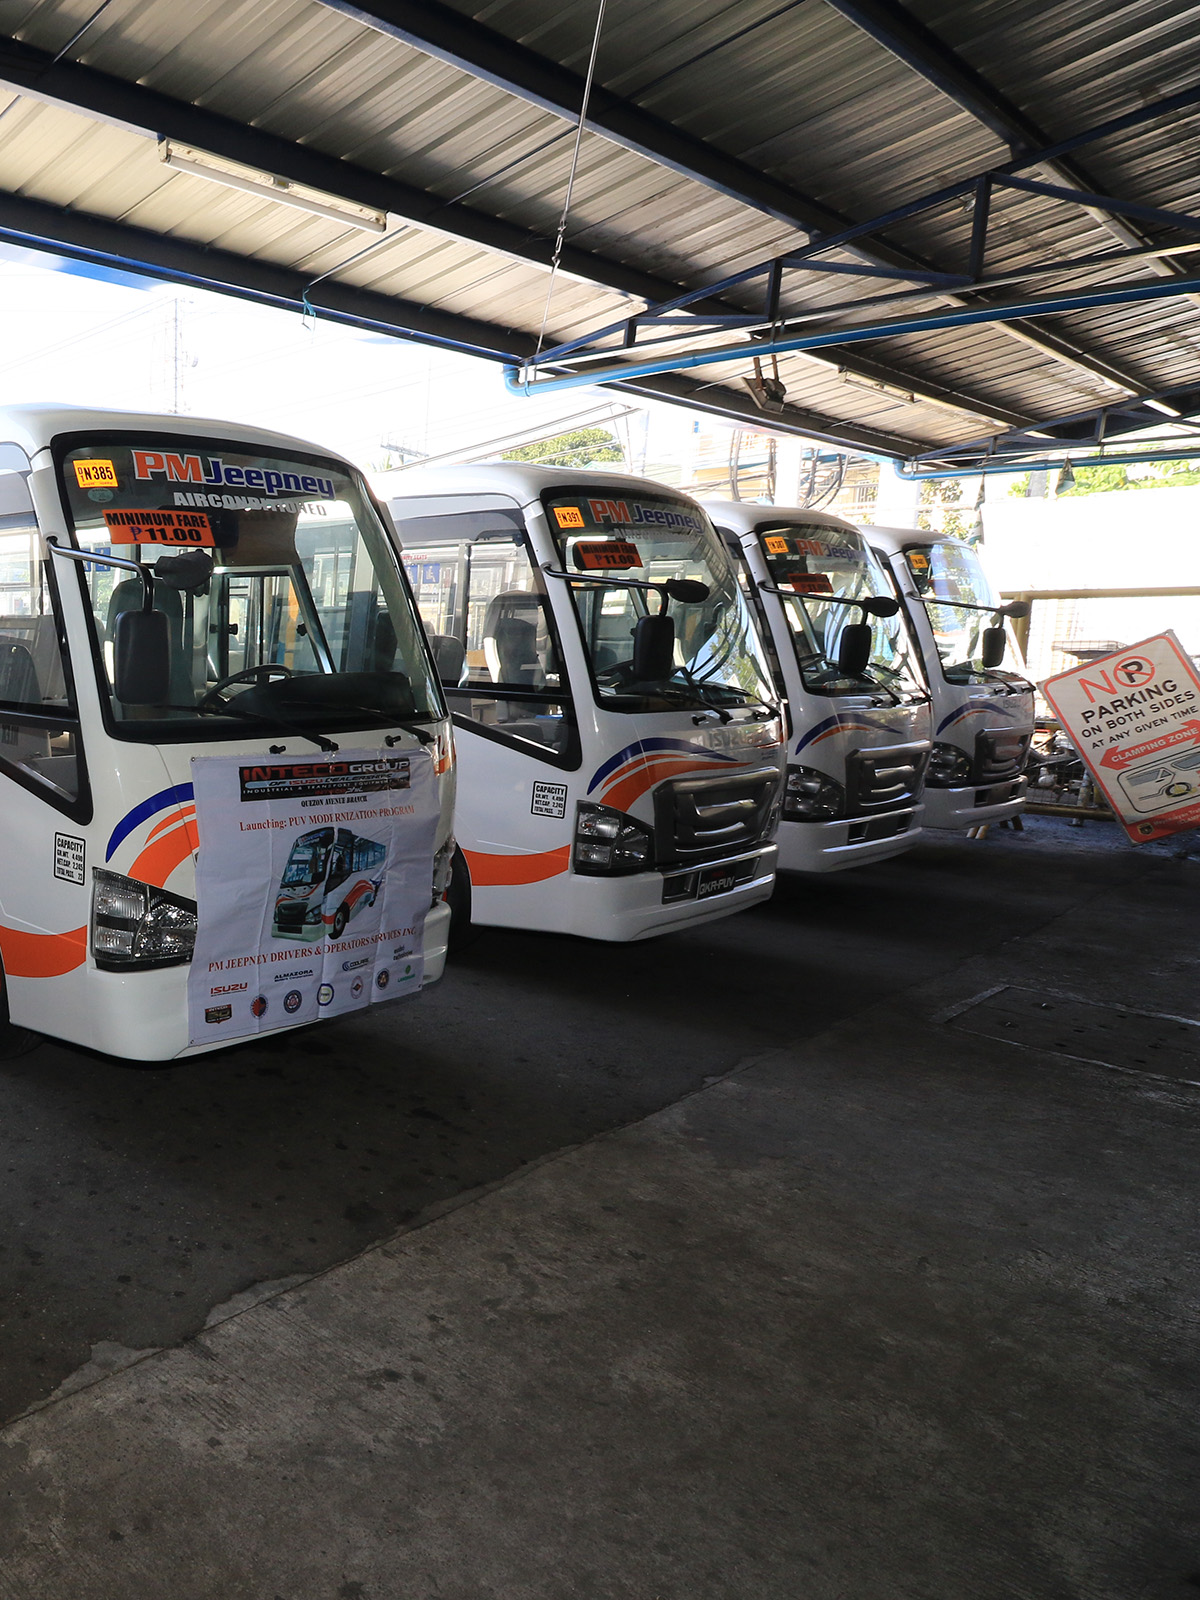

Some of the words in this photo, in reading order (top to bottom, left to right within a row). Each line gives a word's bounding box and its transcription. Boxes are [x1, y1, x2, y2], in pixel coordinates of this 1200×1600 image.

[83, 466, 114, 481] N385
[131, 449, 205, 484] PM
[204, 456, 337, 500] Jeepney
[105, 511, 175, 527] MINIMUM
[177, 513, 207, 528] FARE
[588, 499, 633, 524] PM
[634, 503, 706, 534] Jeepney
[795, 539, 826, 556] PM
[1081, 680, 1177, 724] PARKING
[1081, 725, 1103, 738] ON
[1106, 709, 1145, 730] BOTH
[1149, 690, 1196, 713] SIDES
[1092, 739, 1105, 749] AT
[1109, 730, 1131, 743] ANY
[1134, 716, 1168, 733] GIVEN
[1170, 705, 1200, 720] TIME
[1111, 739, 1167, 763] CLAMPING
[1168, 728, 1200, 743] ZONE
[243, 786, 294, 795] INDUSTRIAL
[289, 778, 324, 786] ISUZU
[536, 785, 565, 795] CAPACITY
[301, 799, 324, 808] QUEZON
[239, 818, 287, 832] Launching:
[289, 816, 307, 826] PUV
[308, 809, 378, 825] MODERNIZATION
[379, 805, 415, 817] PROGRAM
[57, 838, 83, 853] CAPACITY
[700, 876, 735, 895] QKR-PUV
[208, 962, 223, 972] PM
[225, 953, 268, 970] JEEPNEY
[270, 946, 313, 962] DRIVERS
[314, 946, 321, 955] &
[323, 938, 370, 954] OPERATORS
[370, 929, 402, 945] SERVICES
[210, 982, 248, 994] ISUZU
